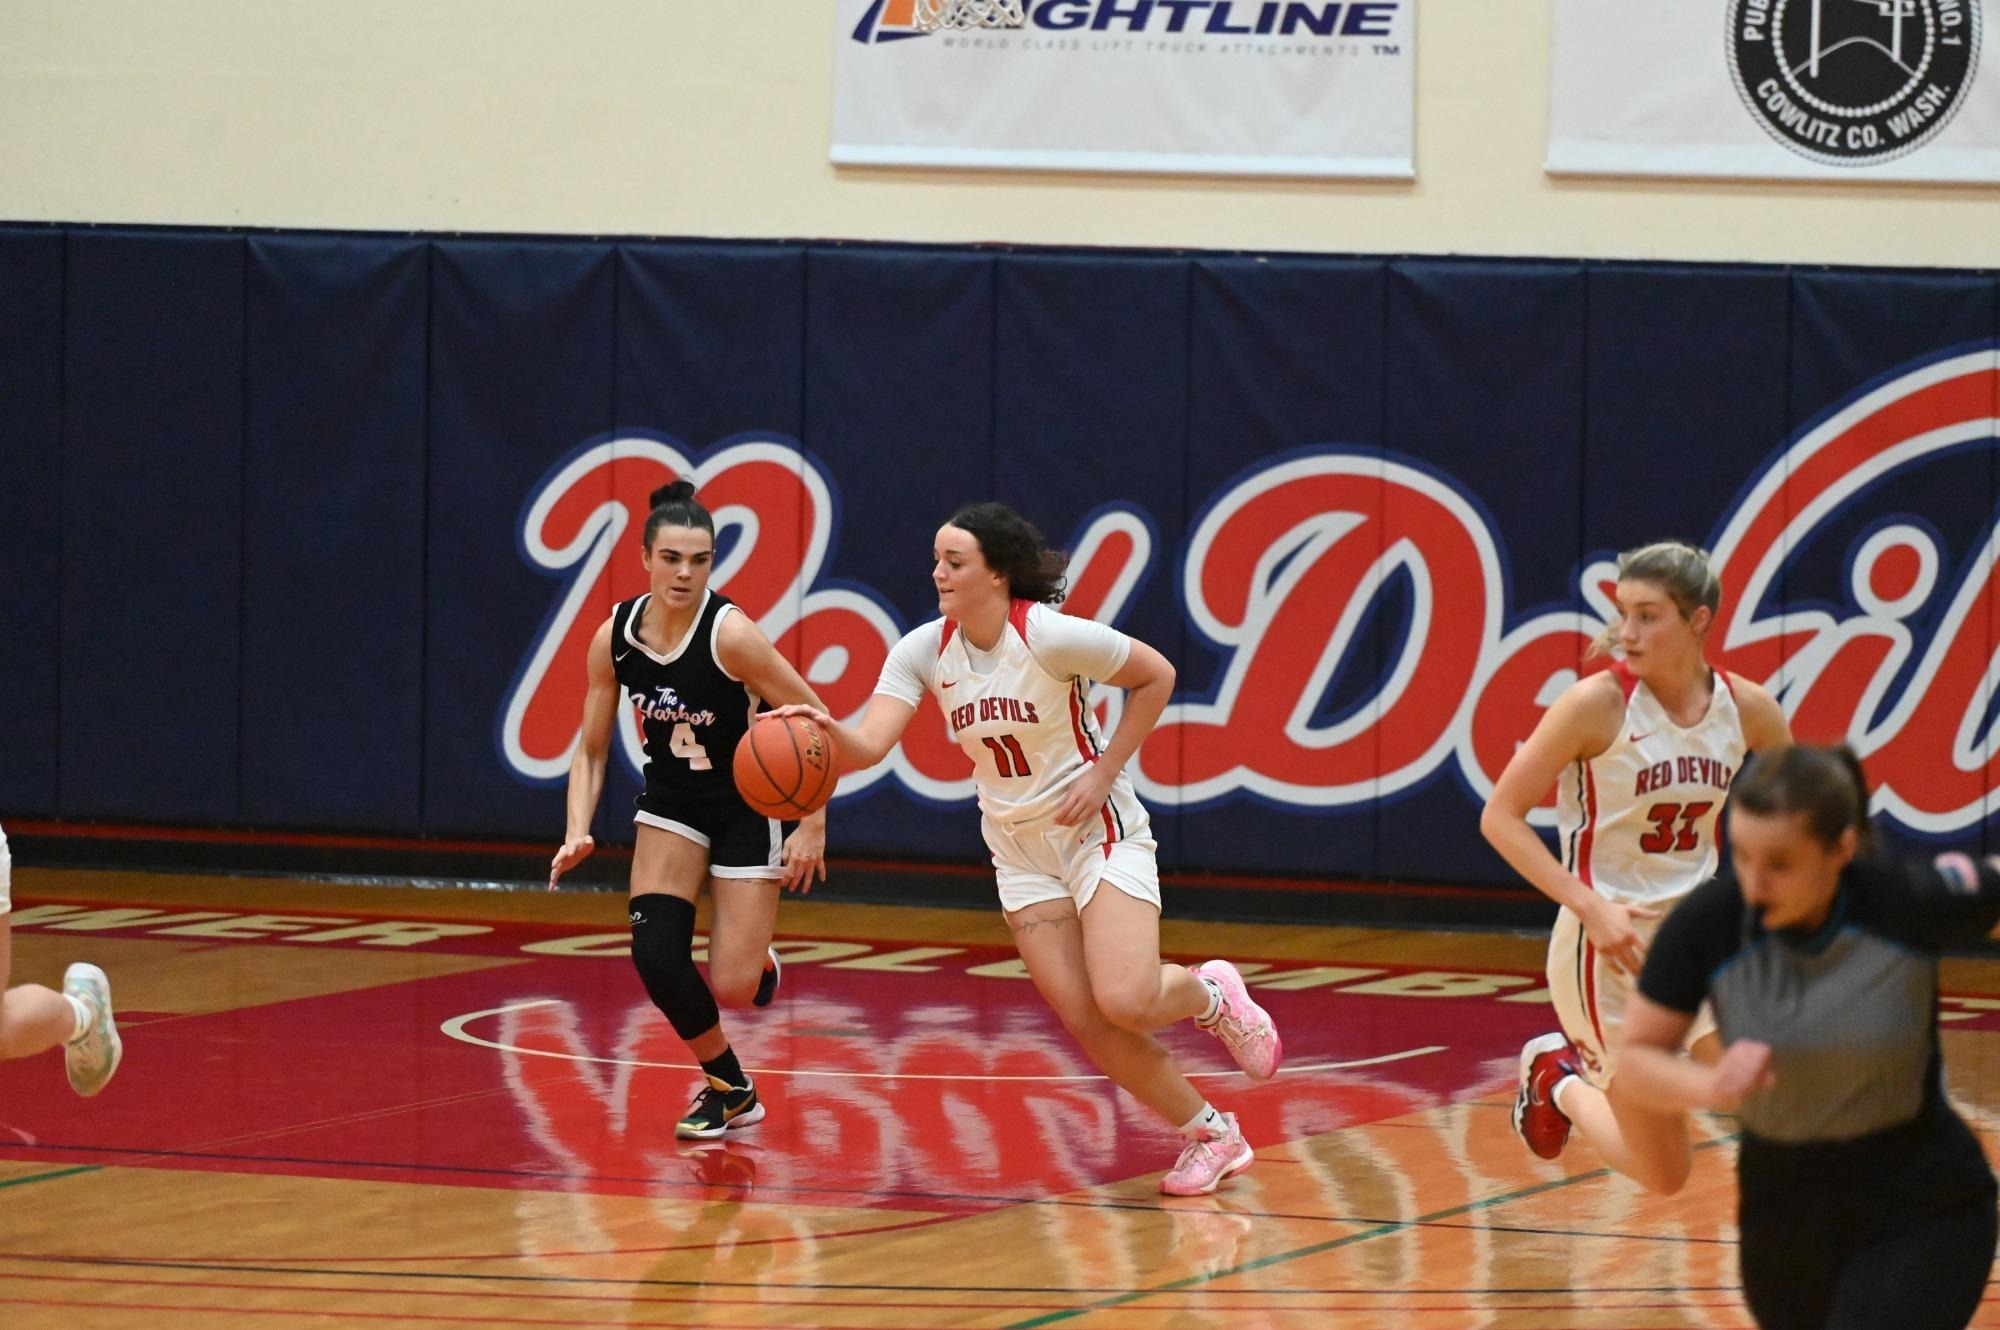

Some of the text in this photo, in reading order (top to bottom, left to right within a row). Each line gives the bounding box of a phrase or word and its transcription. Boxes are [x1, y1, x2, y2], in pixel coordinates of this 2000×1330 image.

[950, 0, 1398, 36] GHTLINE
[943, 38, 1360, 56] WORLD CLASS LIFT TRUCK ATTACHMENTS
[1756, 78, 1951, 149] COWLITZ CO. WASH.
[630, 694, 716, 726] Harbor
[655, 686, 678, 706] The
[951, 697, 1039, 733] RED DEVILS
[669, 723, 713, 771] 4
[981, 734, 1032, 777] 11
[1635, 760, 1671, 796] RED
